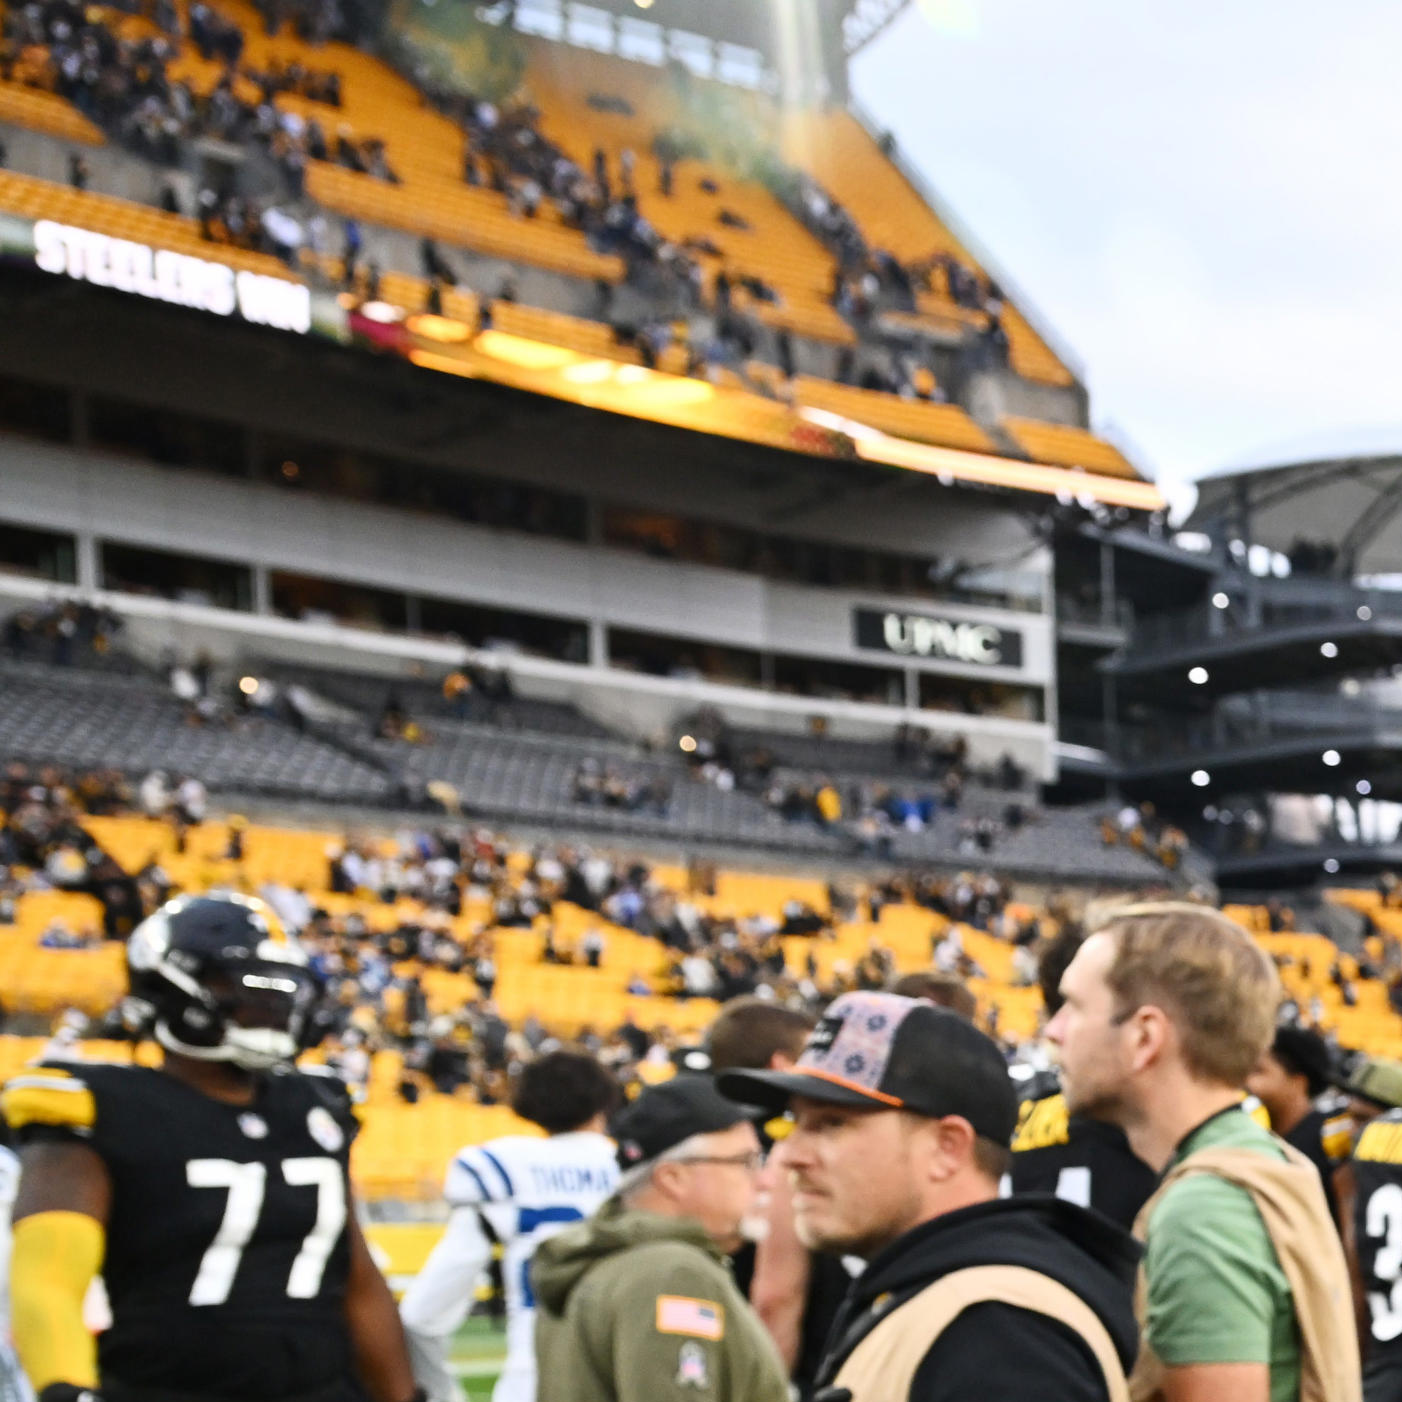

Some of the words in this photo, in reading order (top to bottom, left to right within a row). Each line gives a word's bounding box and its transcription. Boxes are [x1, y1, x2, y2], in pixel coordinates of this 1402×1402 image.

[883, 613, 1001, 665] UPMC
[530, 1166, 612, 1192] THOMA
[185, 1158, 348, 1307] 77
